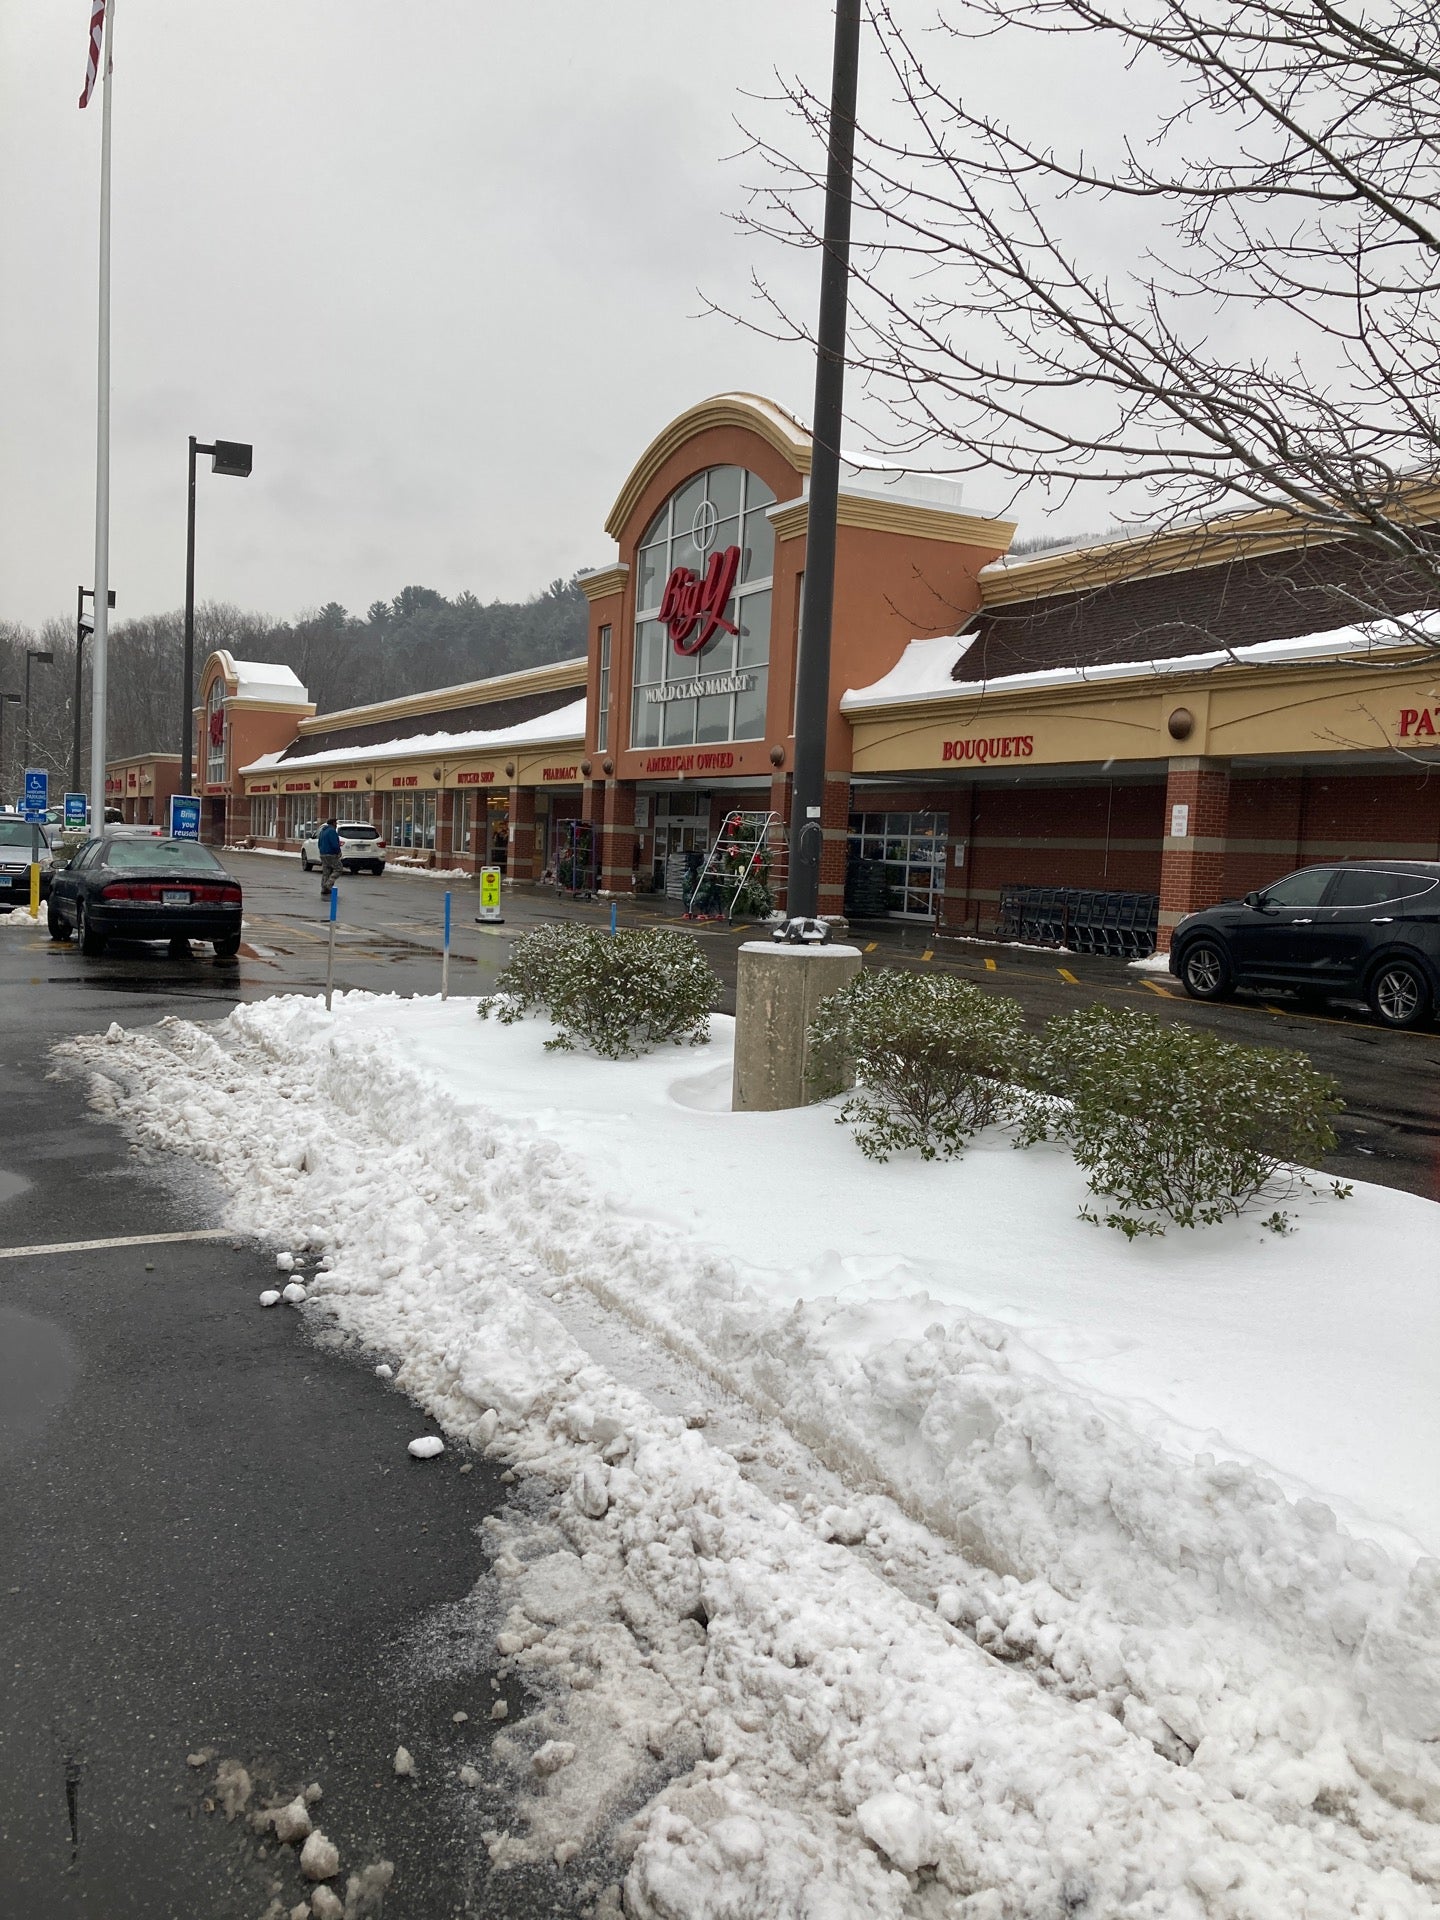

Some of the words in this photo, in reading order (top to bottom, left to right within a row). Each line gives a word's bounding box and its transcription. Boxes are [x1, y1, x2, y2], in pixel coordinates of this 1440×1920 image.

[658, 566, 706, 640] Big
[674, 545, 740, 656] Y
[646, 686, 675, 703] WORLD
[676, 681, 704, 699] CLASS
[705, 674, 749, 696] MARKET
[1400, 708, 1440, 736] PA
[646, 755, 694, 772] AMERICAN
[697, 752, 734, 770] OWNED
[942, 735, 1034, 764] BOUQUETS
[542, 766, 578, 781] PHARMACY
[180, 810, 197, 820] Bring
[182, 821, 195, 829] your
